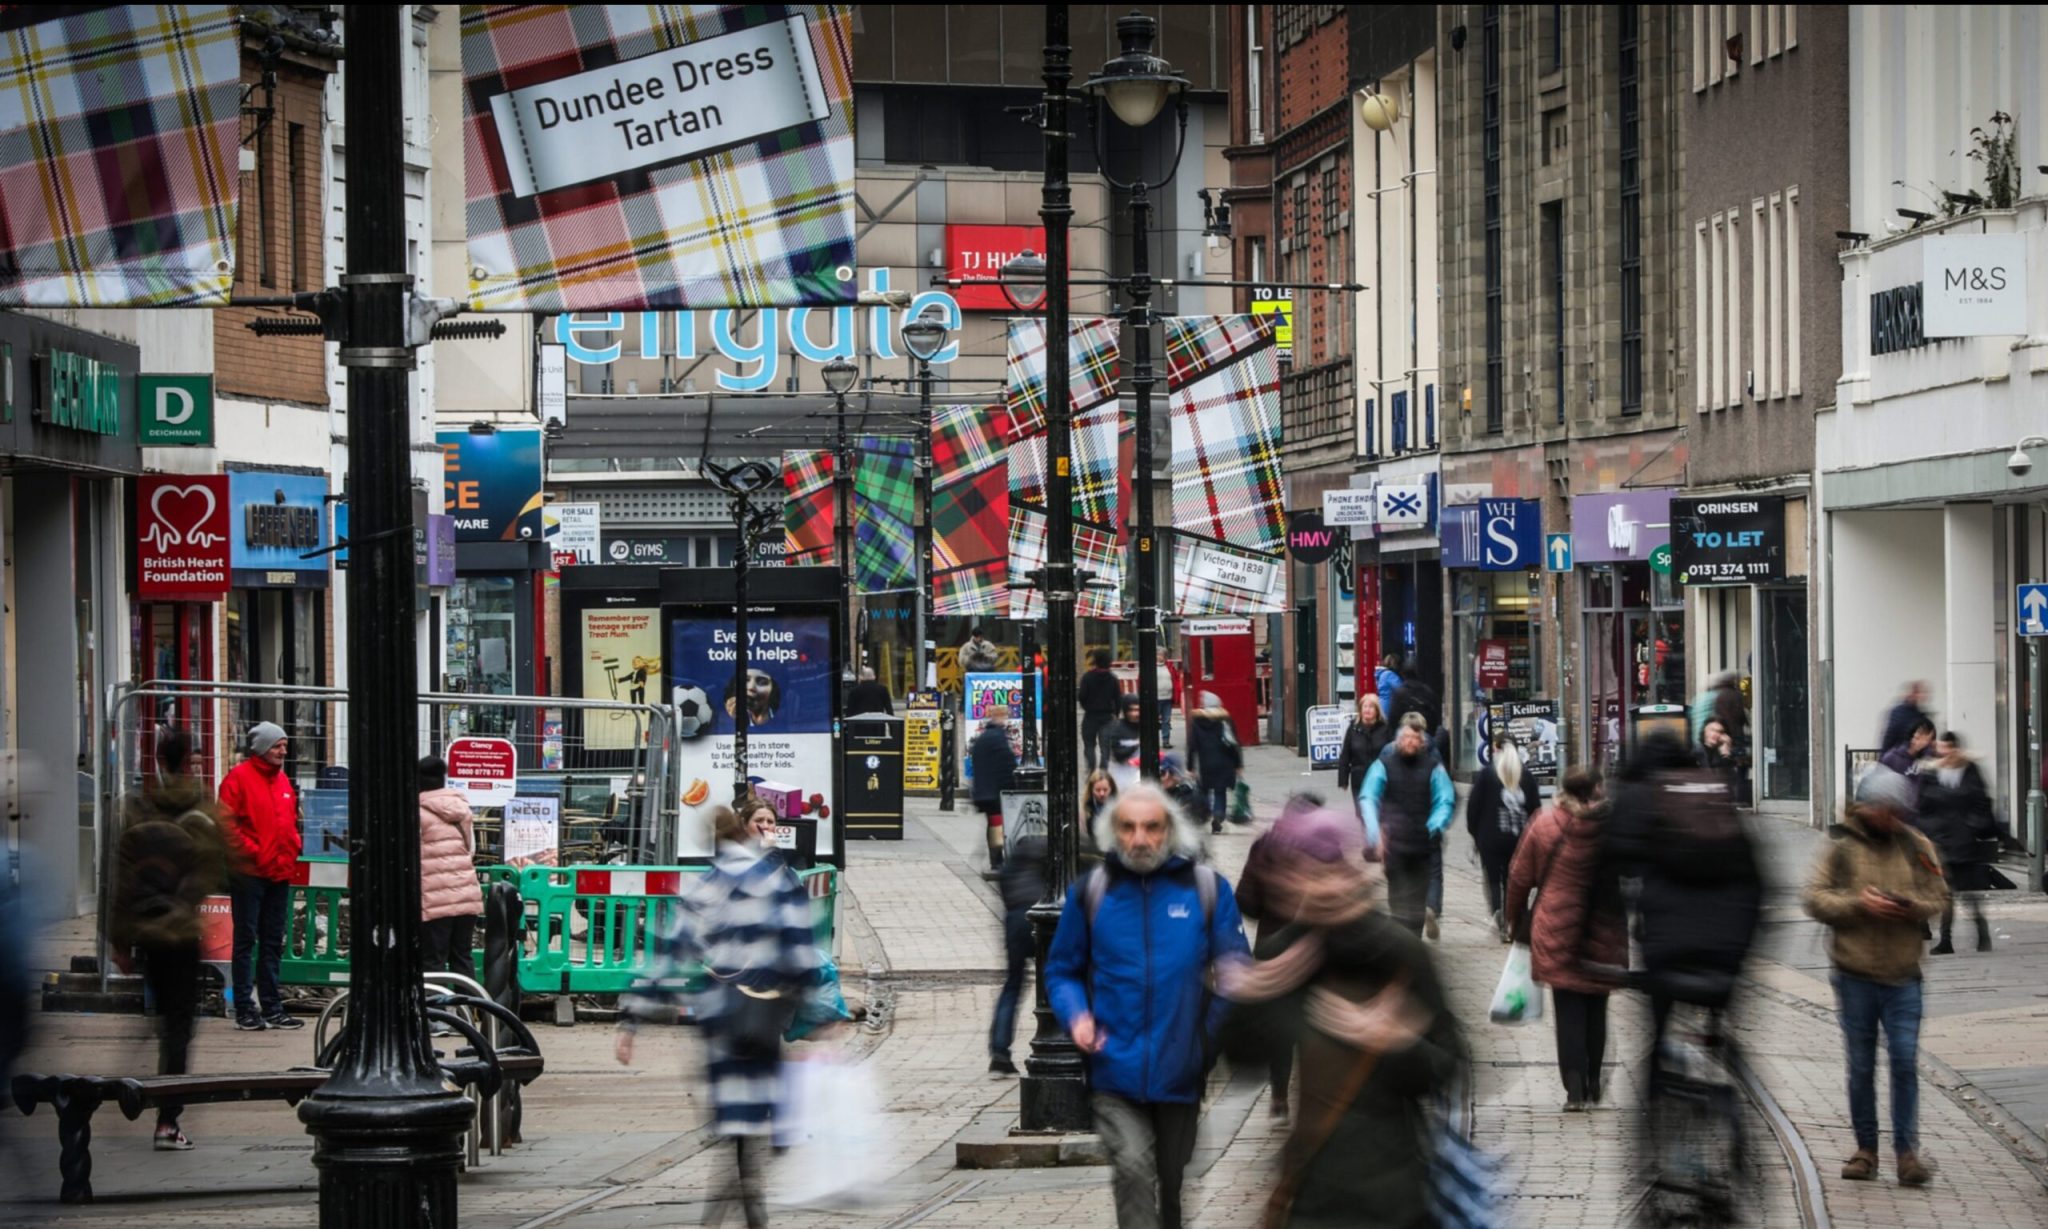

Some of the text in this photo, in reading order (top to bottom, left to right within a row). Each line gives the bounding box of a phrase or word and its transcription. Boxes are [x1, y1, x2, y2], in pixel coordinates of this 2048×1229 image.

[534, 46, 774, 131] Dundee Dress
[613, 103, 723, 151] Tartan
[961, 251, 980, 269] TJ
[1945, 266, 2006, 291] M&S
[1253, 287, 1292, 300] TO LE
[1327, 494, 1353, 504] PHONE
[1485, 502, 1516, 517] WH
[1697, 502, 1759, 515] ORINSEN
[1290, 531, 1332, 547] HMV
[1461, 510, 1480, 562] WH
[1486, 516, 1518, 566] S
[1692, 530, 1764, 548] TO LET
[633, 543, 664, 557] GYMS
[759, 542, 785, 555] GYMS
[143, 557, 224, 569] British Heart
[1203, 551, 1264, 575] Victoria 1838
[1656, 552, 1672, 569] Sp
[1216, 568, 1247, 584] Tartan
[1688, 562, 1769, 576] 0131 374 1111
[143, 570, 224, 583] Foundation
[588, 614, 650, 623] Remember your
[588, 622, 648, 631] teenage years?
[713, 629, 794, 646] Evey blue
[971, 679, 1023, 690] YVONN
[972, 689, 1023, 705] FANC
[1512, 703, 1551, 716] Keillers
[470, 741, 493, 750] Clancy
[716, 742, 731, 750] Use
[758, 742, 766, 750] in
[768, 742, 790, 750] store
[748, 751, 773, 760] ealthy
[775, 751, 795, 759] food
[760, 761, 772, 769] for
